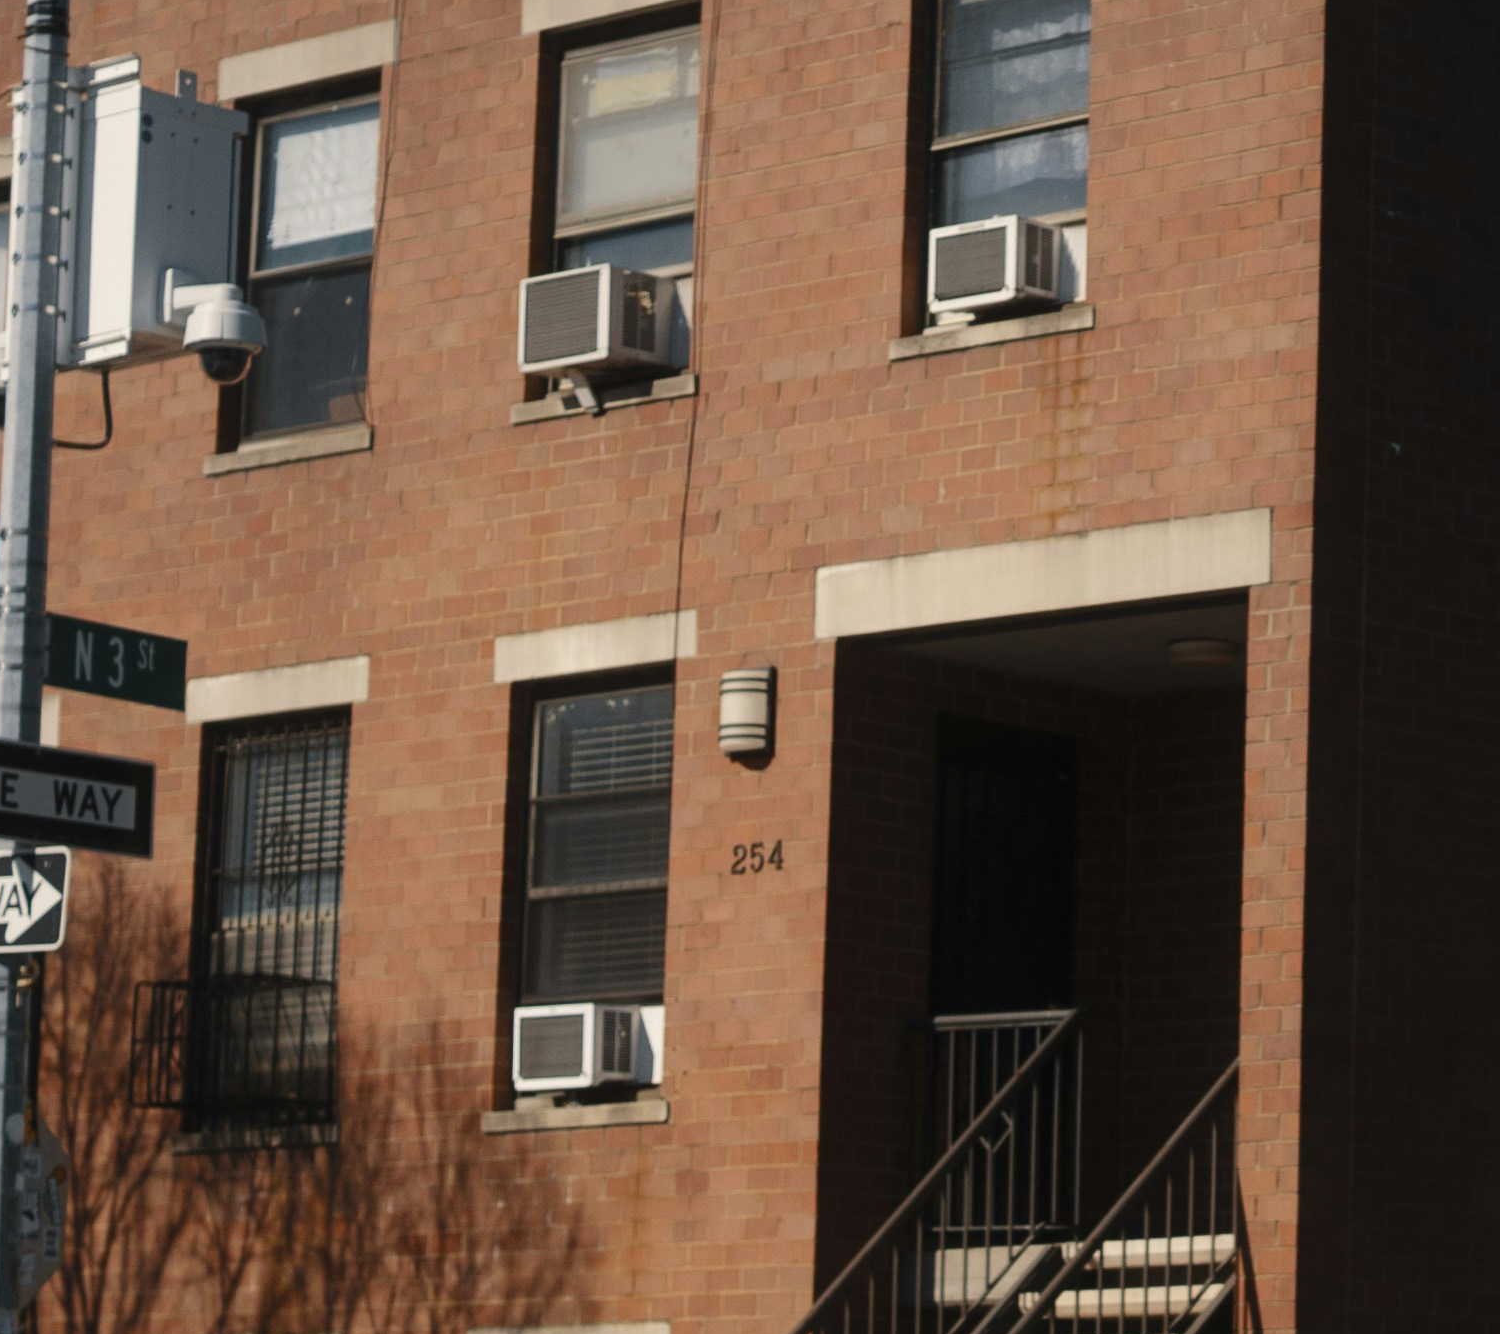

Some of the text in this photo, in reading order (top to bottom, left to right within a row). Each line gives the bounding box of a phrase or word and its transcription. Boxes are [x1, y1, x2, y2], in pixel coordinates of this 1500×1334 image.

[74, 629, 156, 688] N 3 St
[52, 778, 123, 822] WAY
[730, 839, 785, 875] 254
